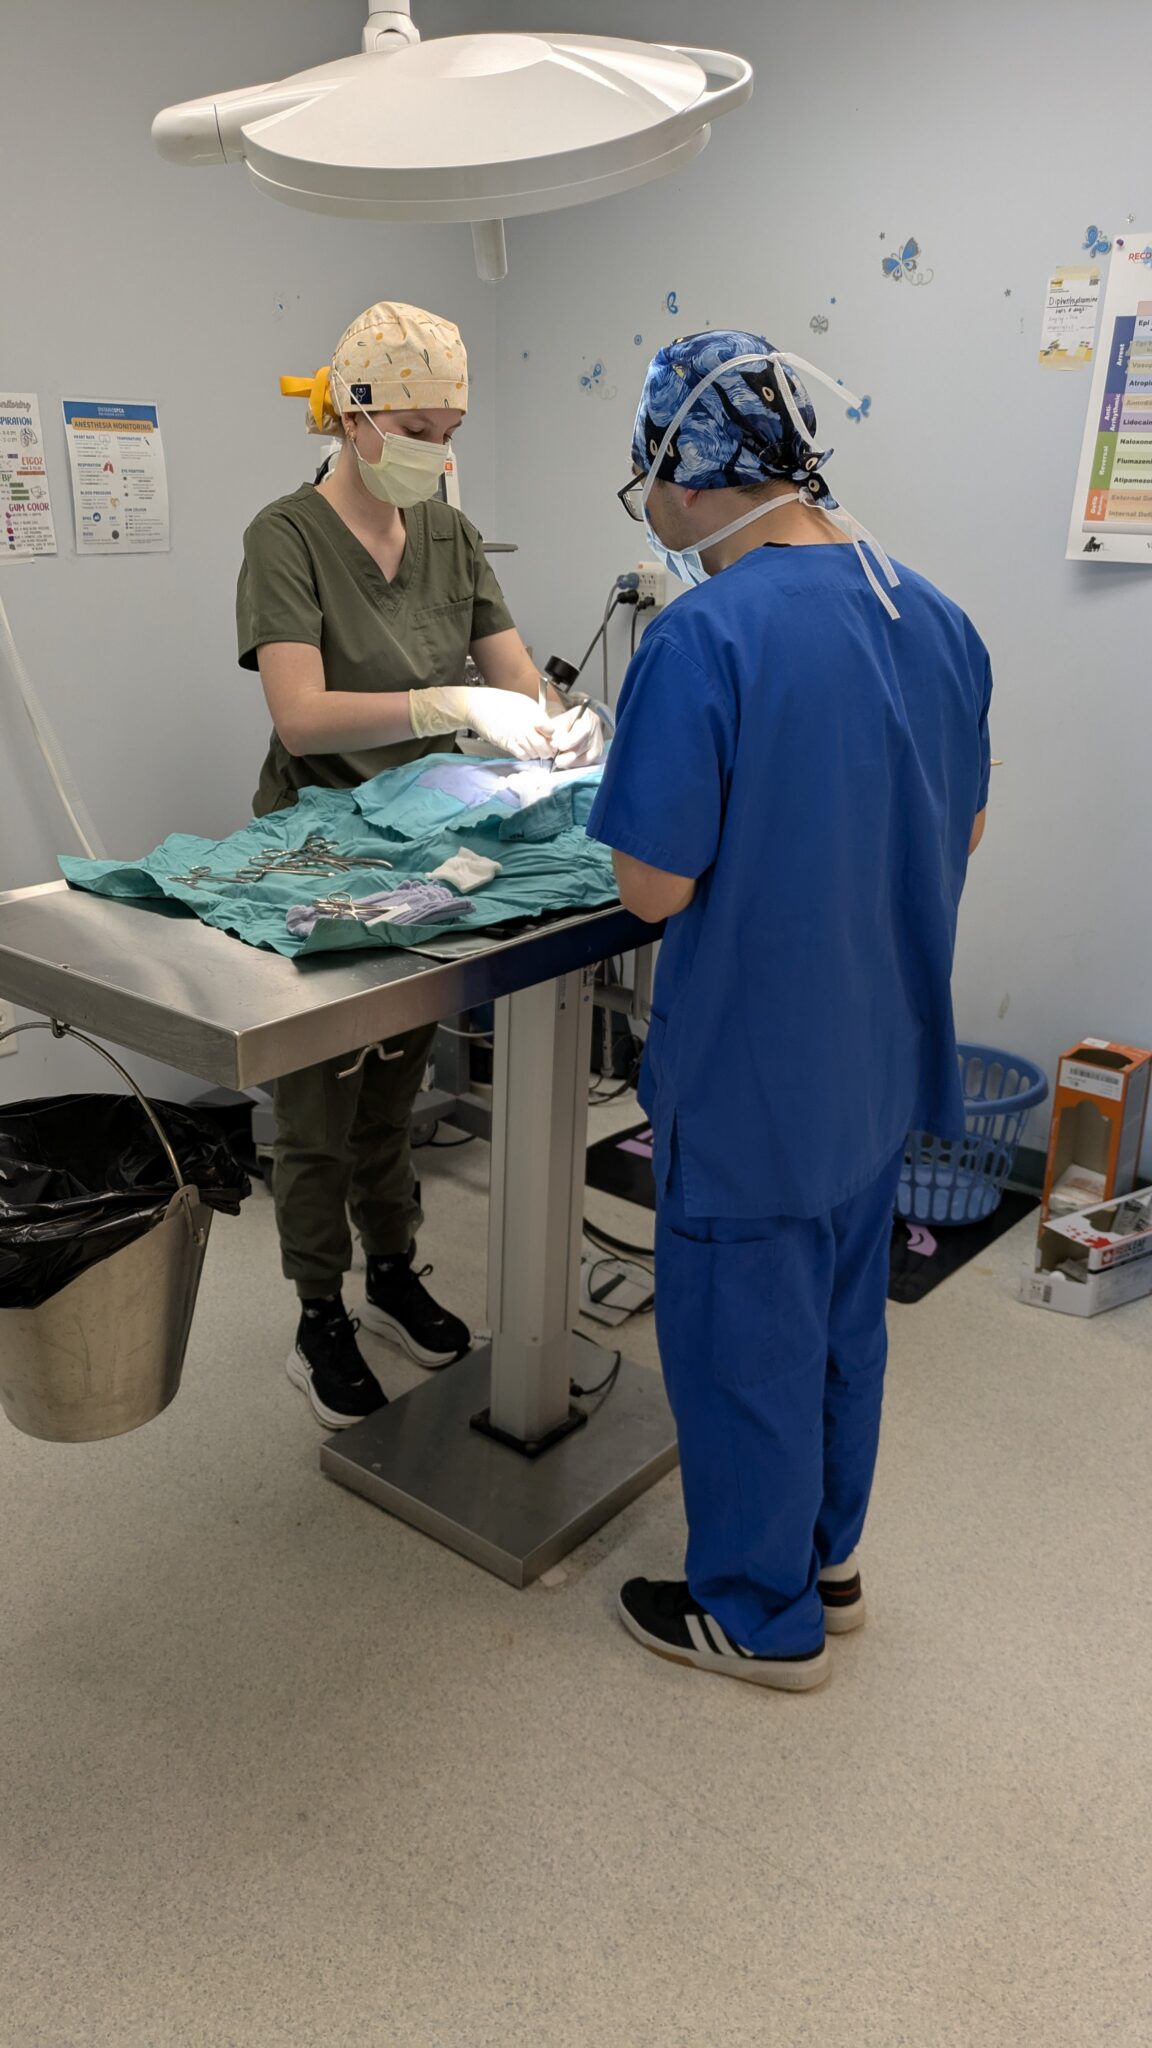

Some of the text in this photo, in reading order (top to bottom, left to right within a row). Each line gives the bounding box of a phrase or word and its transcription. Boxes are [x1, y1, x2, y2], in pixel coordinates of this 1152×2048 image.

[1128, 252, 1152, 264] RECO
[1116, 344, 1125, 366] Arrest
[1110, 393, 1121, 432] Arrhythmic
[74, 421, 151, 431] ANESTHESIA MONITORING
[8, 502, 50, 513] GUM COLOR
